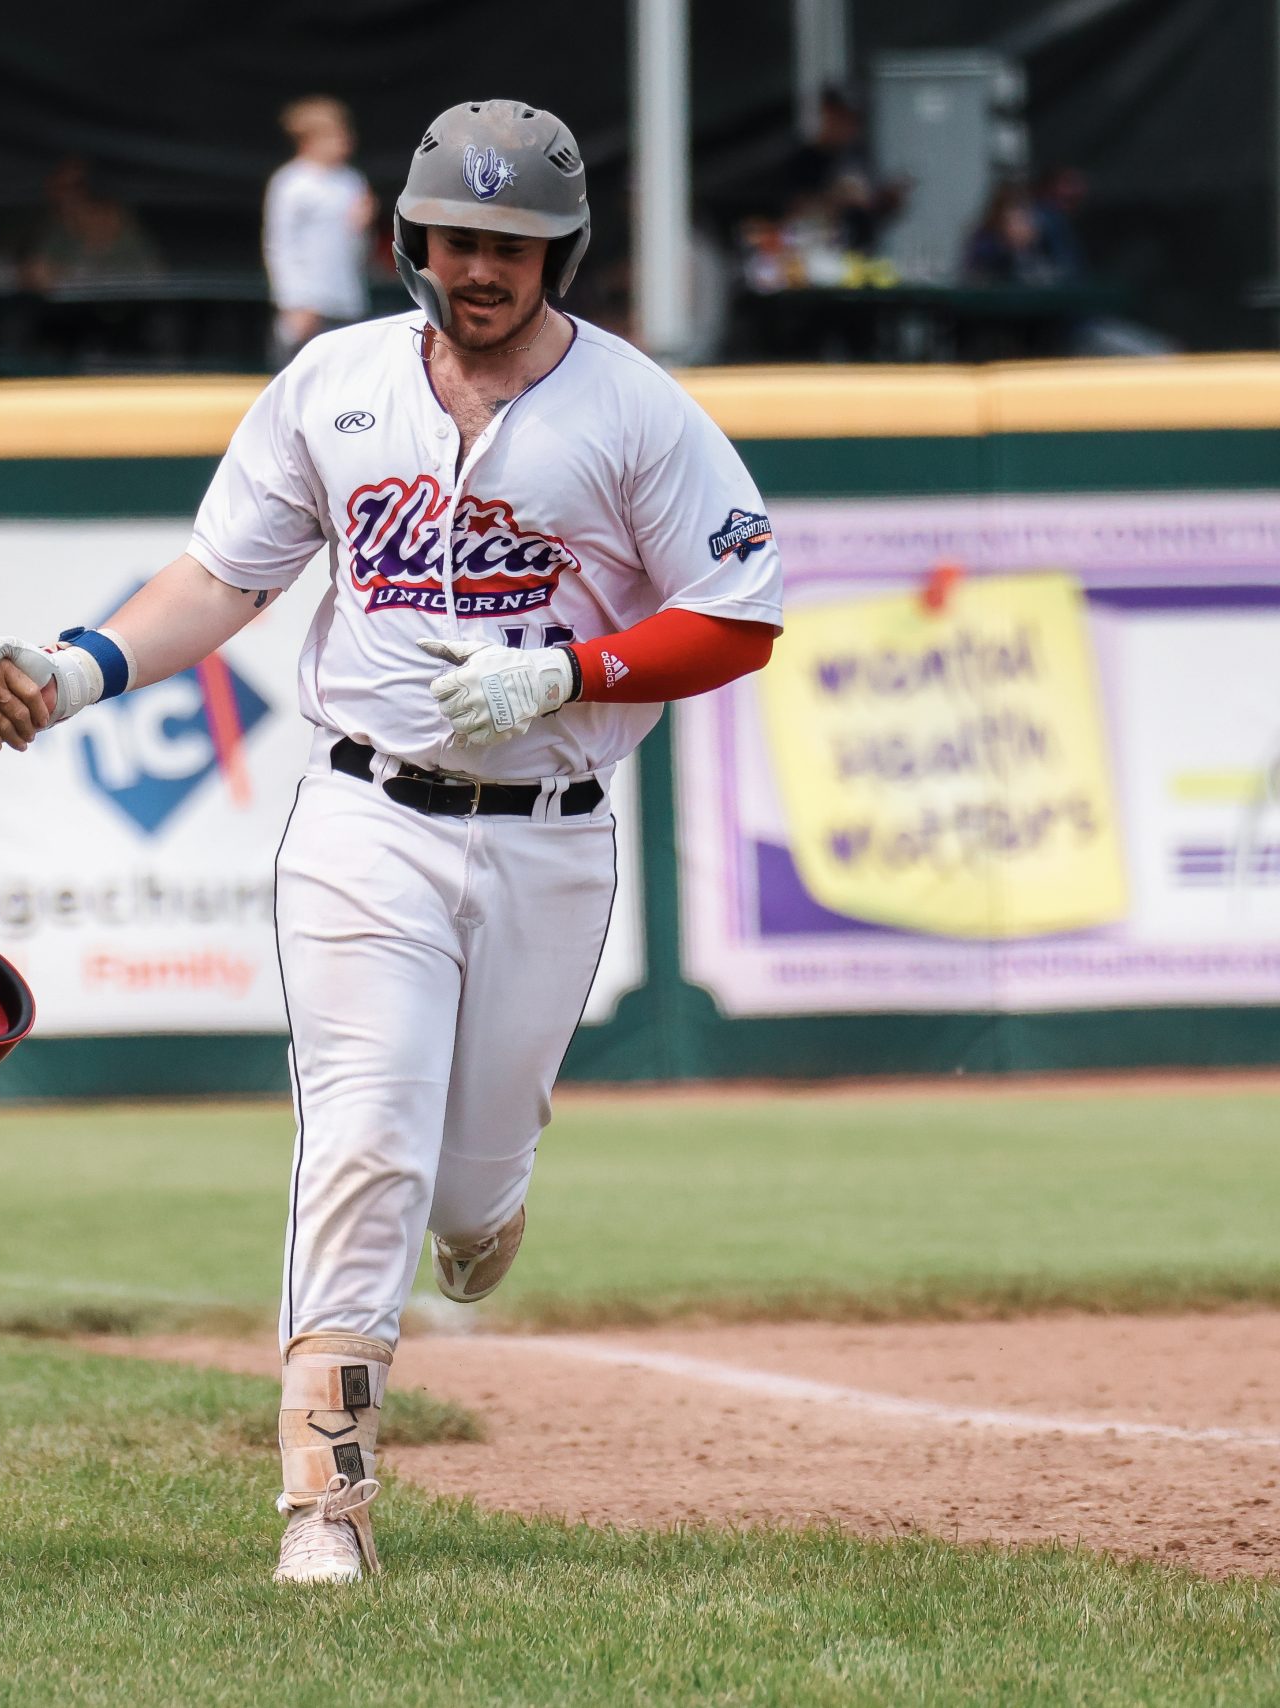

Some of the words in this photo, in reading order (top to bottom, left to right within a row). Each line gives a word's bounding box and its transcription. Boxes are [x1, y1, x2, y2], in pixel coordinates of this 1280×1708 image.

[348, 478, 581, 588] Utica
[375, 587, 548, 613] UNICORNS
[601, 651, 616, 688] adidas
